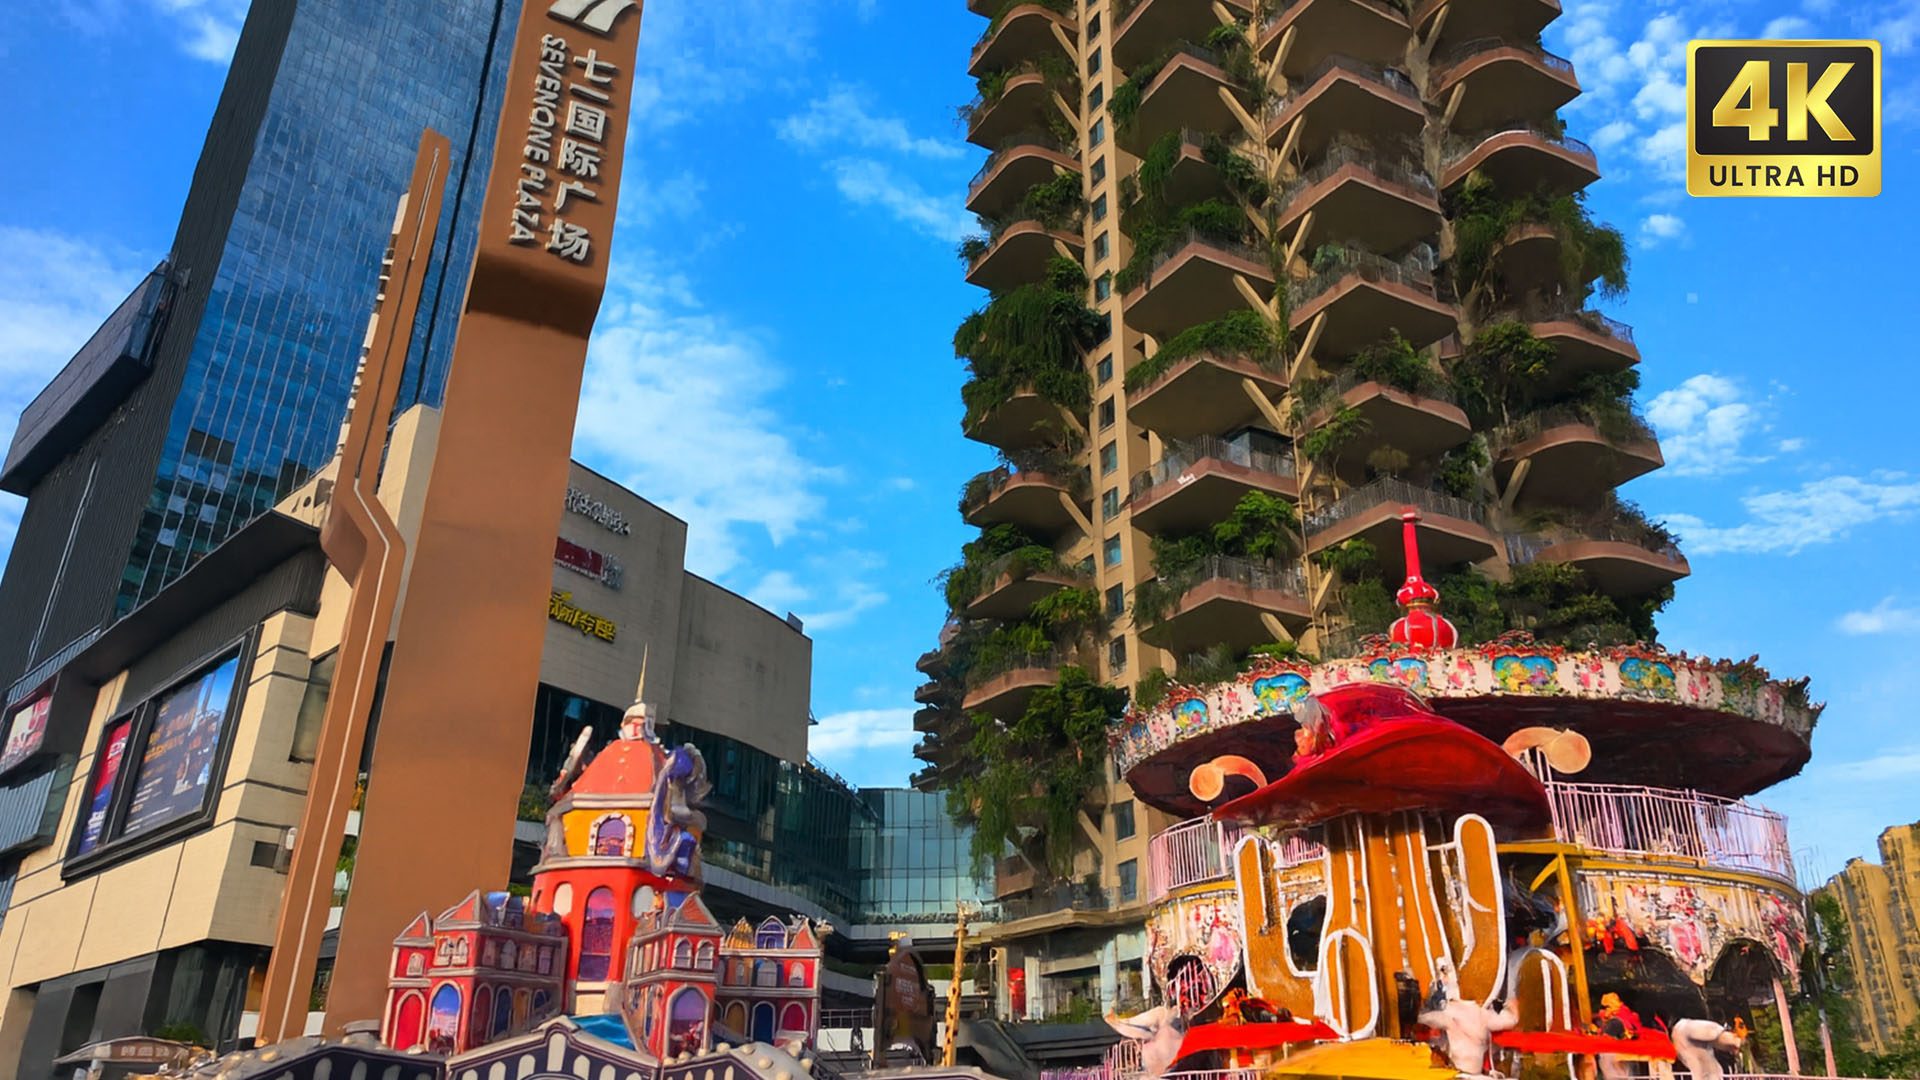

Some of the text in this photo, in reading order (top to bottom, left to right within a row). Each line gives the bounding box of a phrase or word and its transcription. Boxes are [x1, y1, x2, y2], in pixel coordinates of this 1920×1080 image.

[509, 33, 567, 244] SEVENONE PLAZA
[545, 48, 617, 263] 七一国际广场
